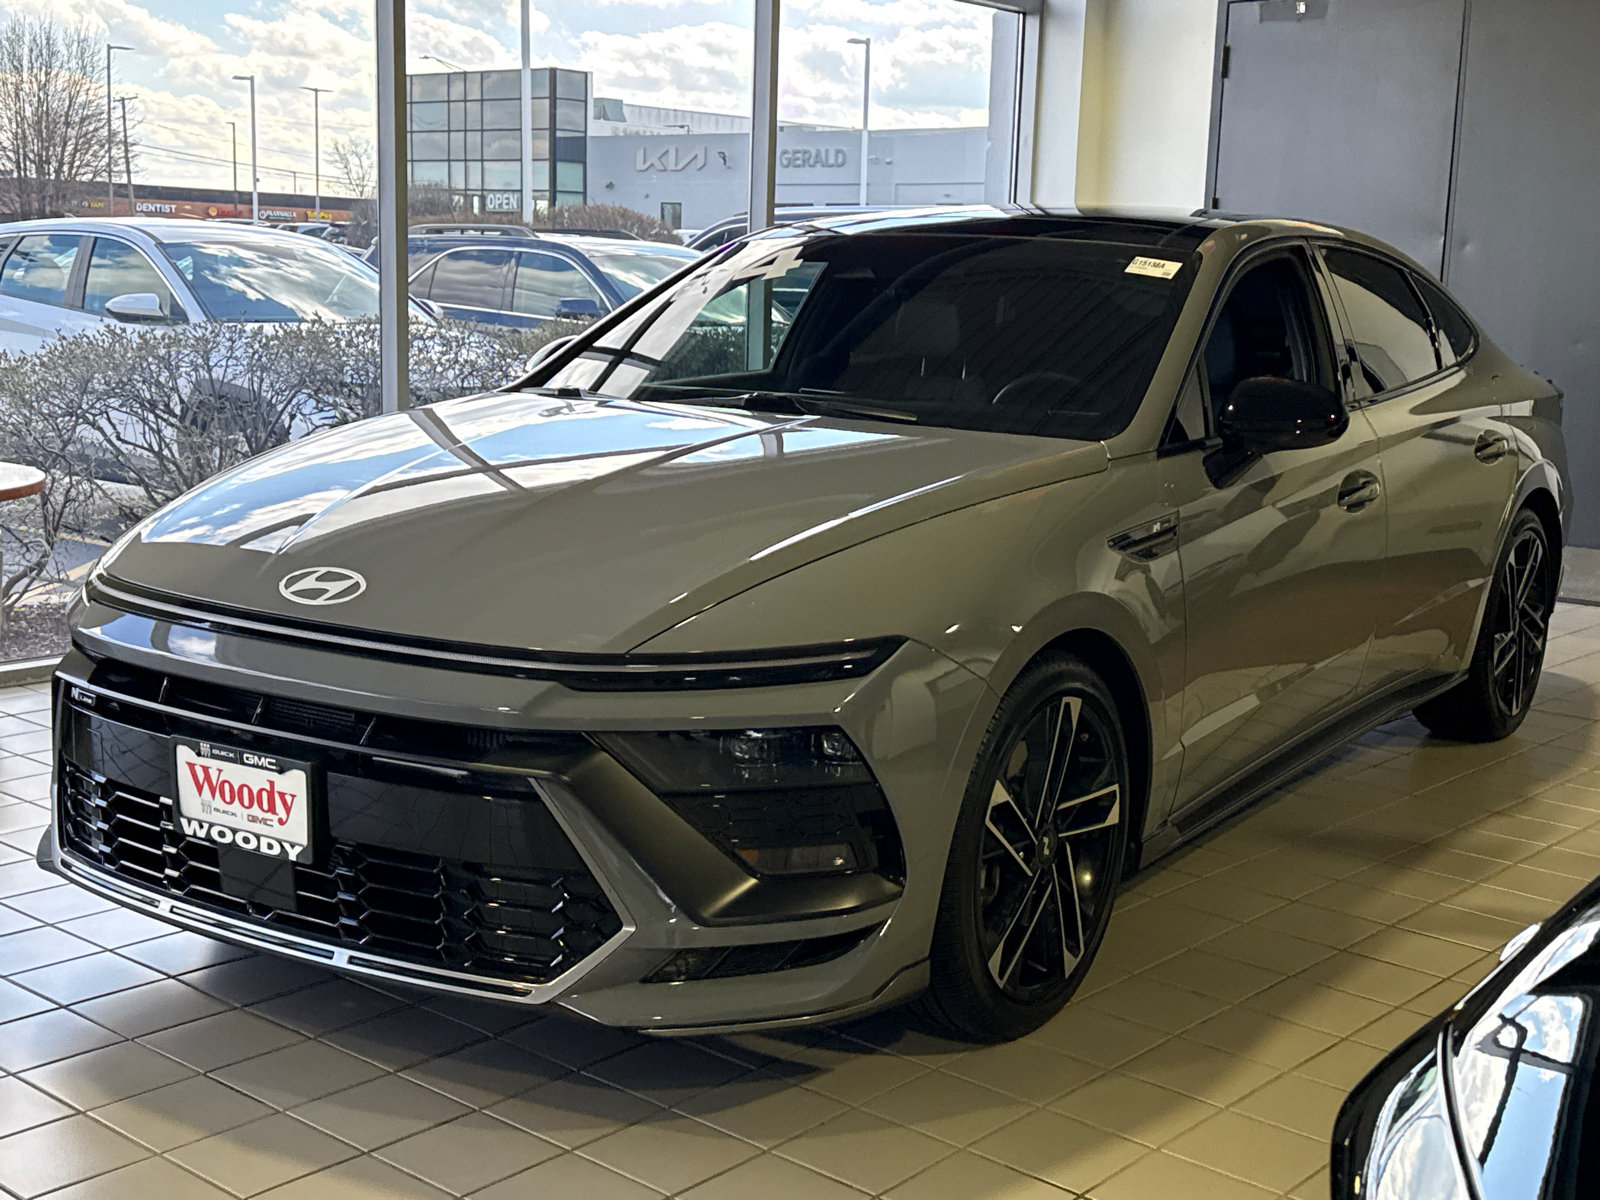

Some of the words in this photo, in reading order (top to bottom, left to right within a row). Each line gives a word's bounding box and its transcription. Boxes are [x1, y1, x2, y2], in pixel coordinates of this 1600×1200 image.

[780, 150, 846, 168] GERALD
[135, 203, 177, 213] DENTIST
[487, 194, 518, 210] OPEN
[211, 749, 235, 758] BUICK
[243, 753, 277, 770] GMC
[185, 761, 297, 826] Woody
[213, 807, 237, 818] BUICK
[247, 814, 274, 828] GMC
[179, 817, 303, 862] WOODY
